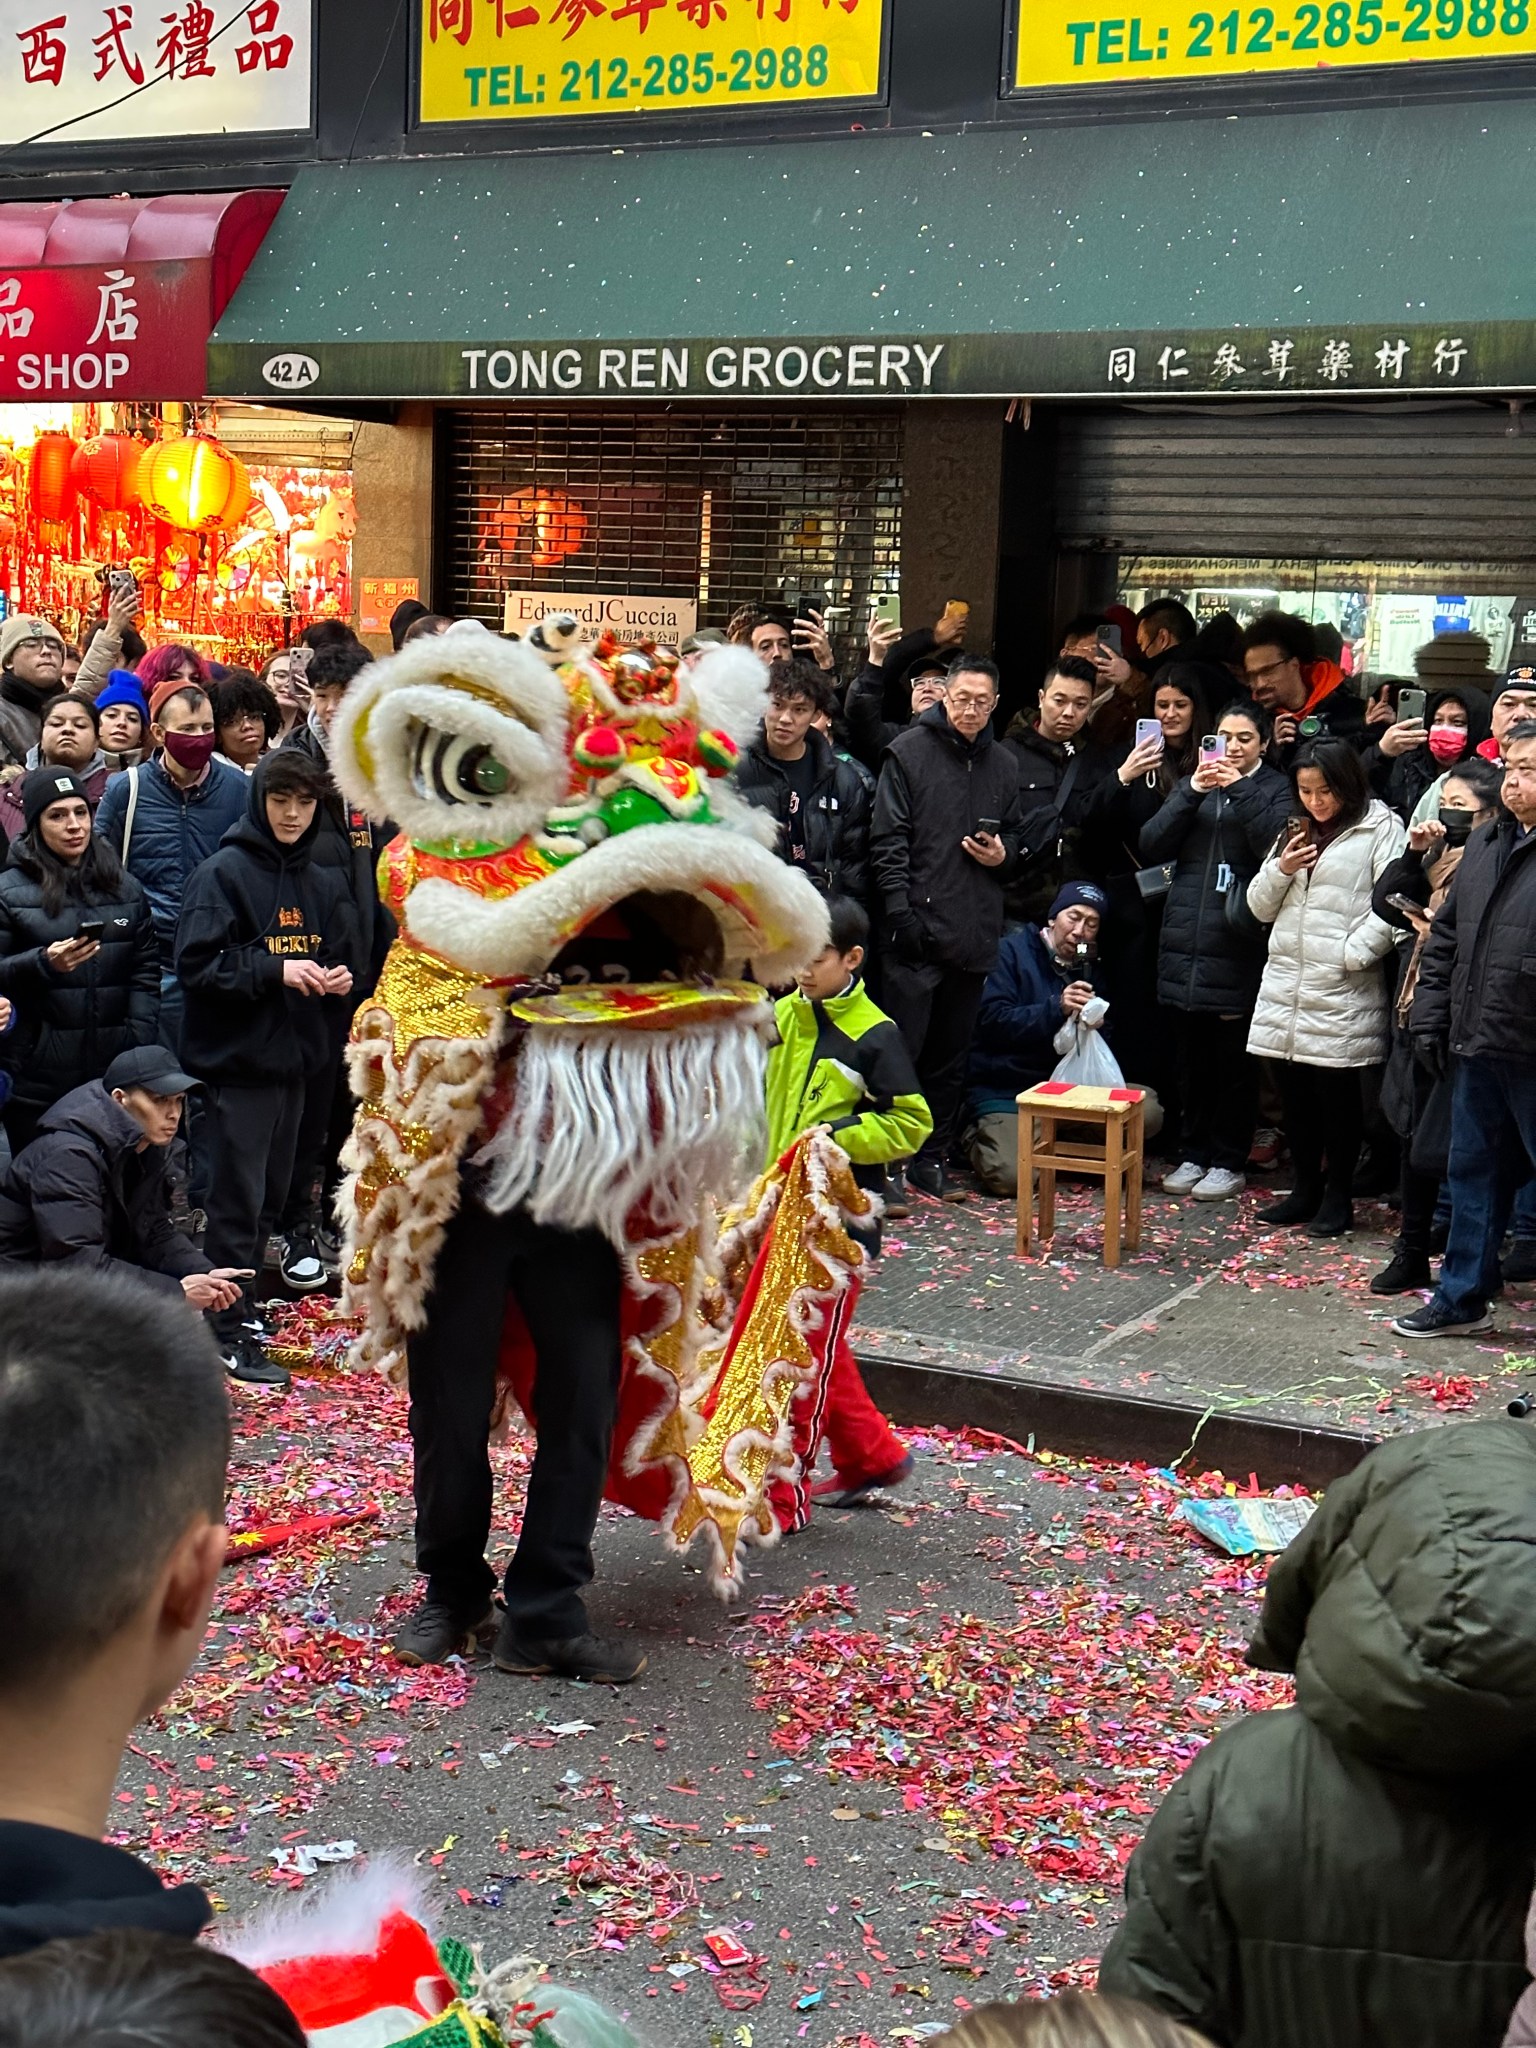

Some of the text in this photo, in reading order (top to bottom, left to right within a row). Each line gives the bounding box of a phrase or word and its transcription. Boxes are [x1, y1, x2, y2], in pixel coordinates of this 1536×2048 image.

[16, 0, 294, 86] 西式禮品
[1066, 0, 1530, 66] TEL: 212-285-2988
[464, 44, 828, 107] TEL: 212-285-2988
[17, 352, 130, 390] SHOP
[461, 344, 945, 389] TONG REN GROCERY
